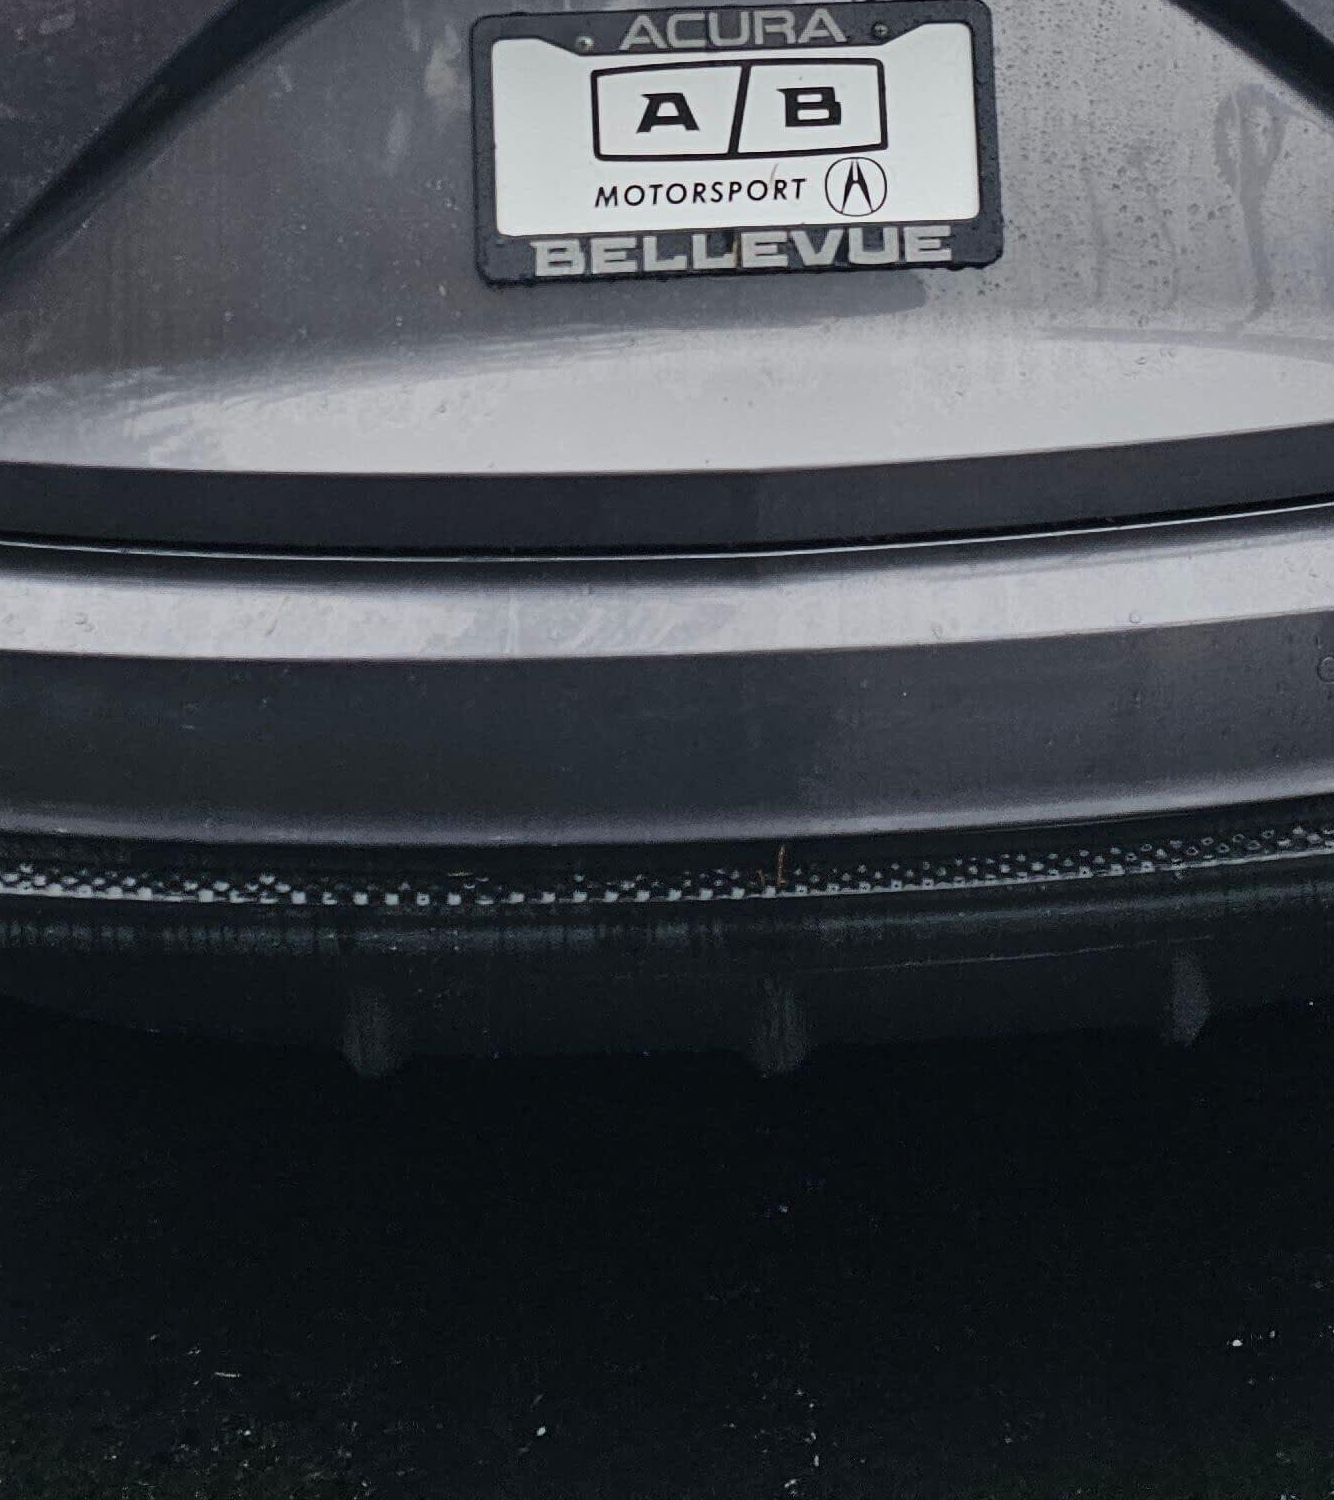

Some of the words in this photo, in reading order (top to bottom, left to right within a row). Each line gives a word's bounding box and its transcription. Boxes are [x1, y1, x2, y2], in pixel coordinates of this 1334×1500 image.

[619, 8, 847, 51] ACURA
[636, 92, 700, 133] A
[776, 86, 842, 128] B
[594, 178, 808, 208] MOTORSPORT
[530, 225, 953, 278] BELLEVUE
